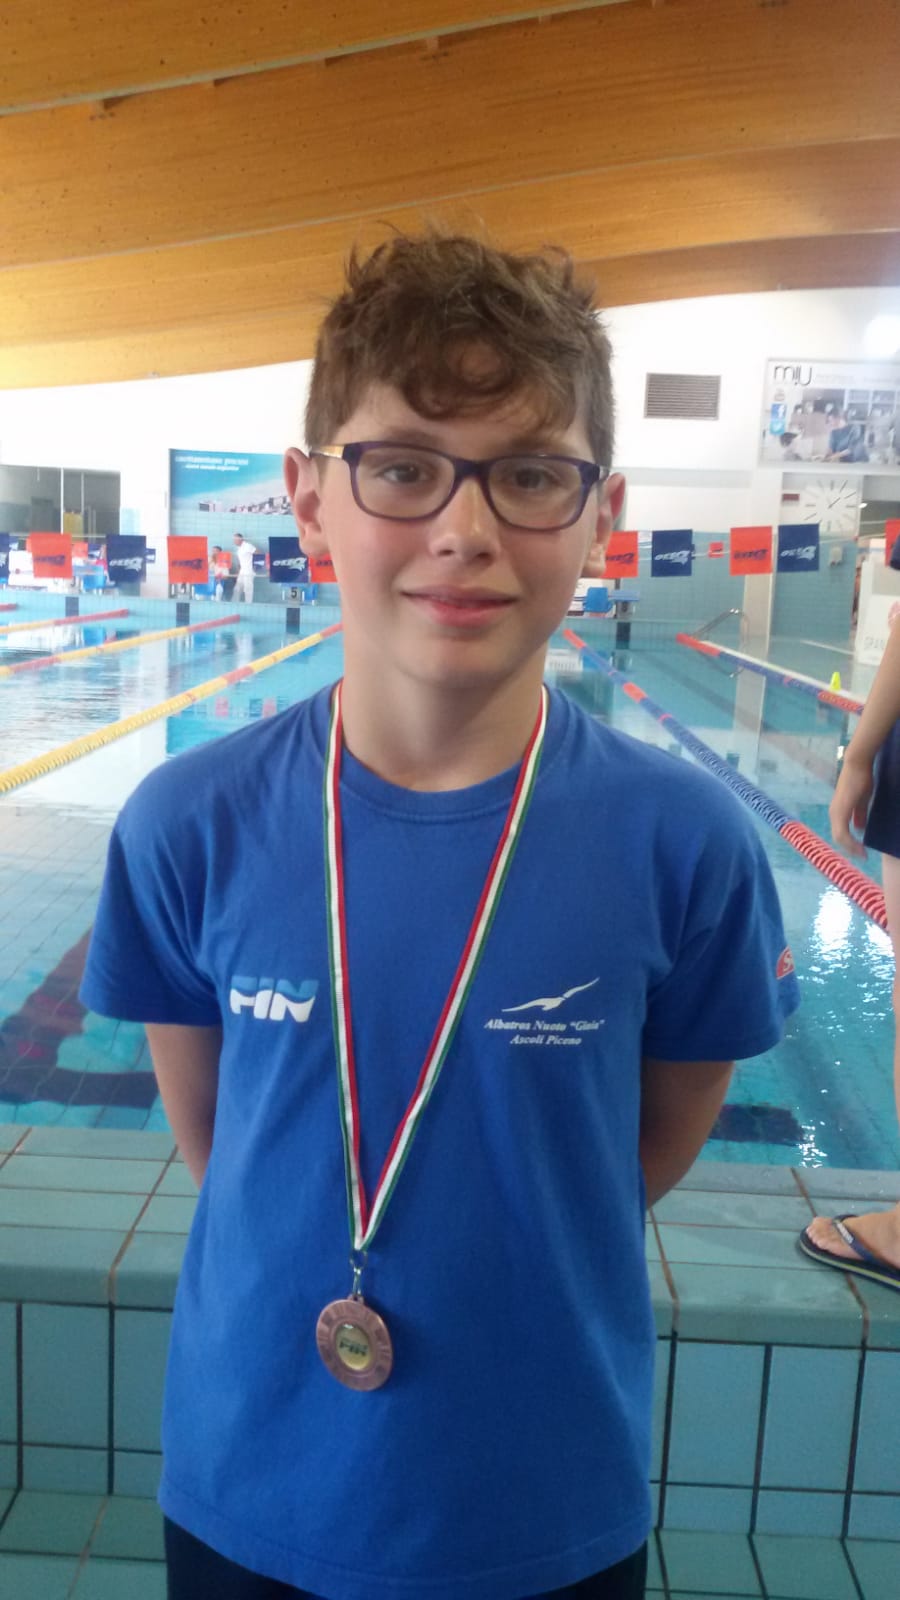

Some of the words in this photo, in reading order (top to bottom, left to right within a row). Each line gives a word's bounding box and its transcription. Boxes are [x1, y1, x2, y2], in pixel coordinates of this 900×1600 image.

[290, 587, 298, 599] 5
[229, 975, 319, 1023] FIN
[532, 1019, 567, 1031] Nuoto
[510, 1034, 544, 1045] Ascoli
[545, 1035, 582, 1046] Piceno
